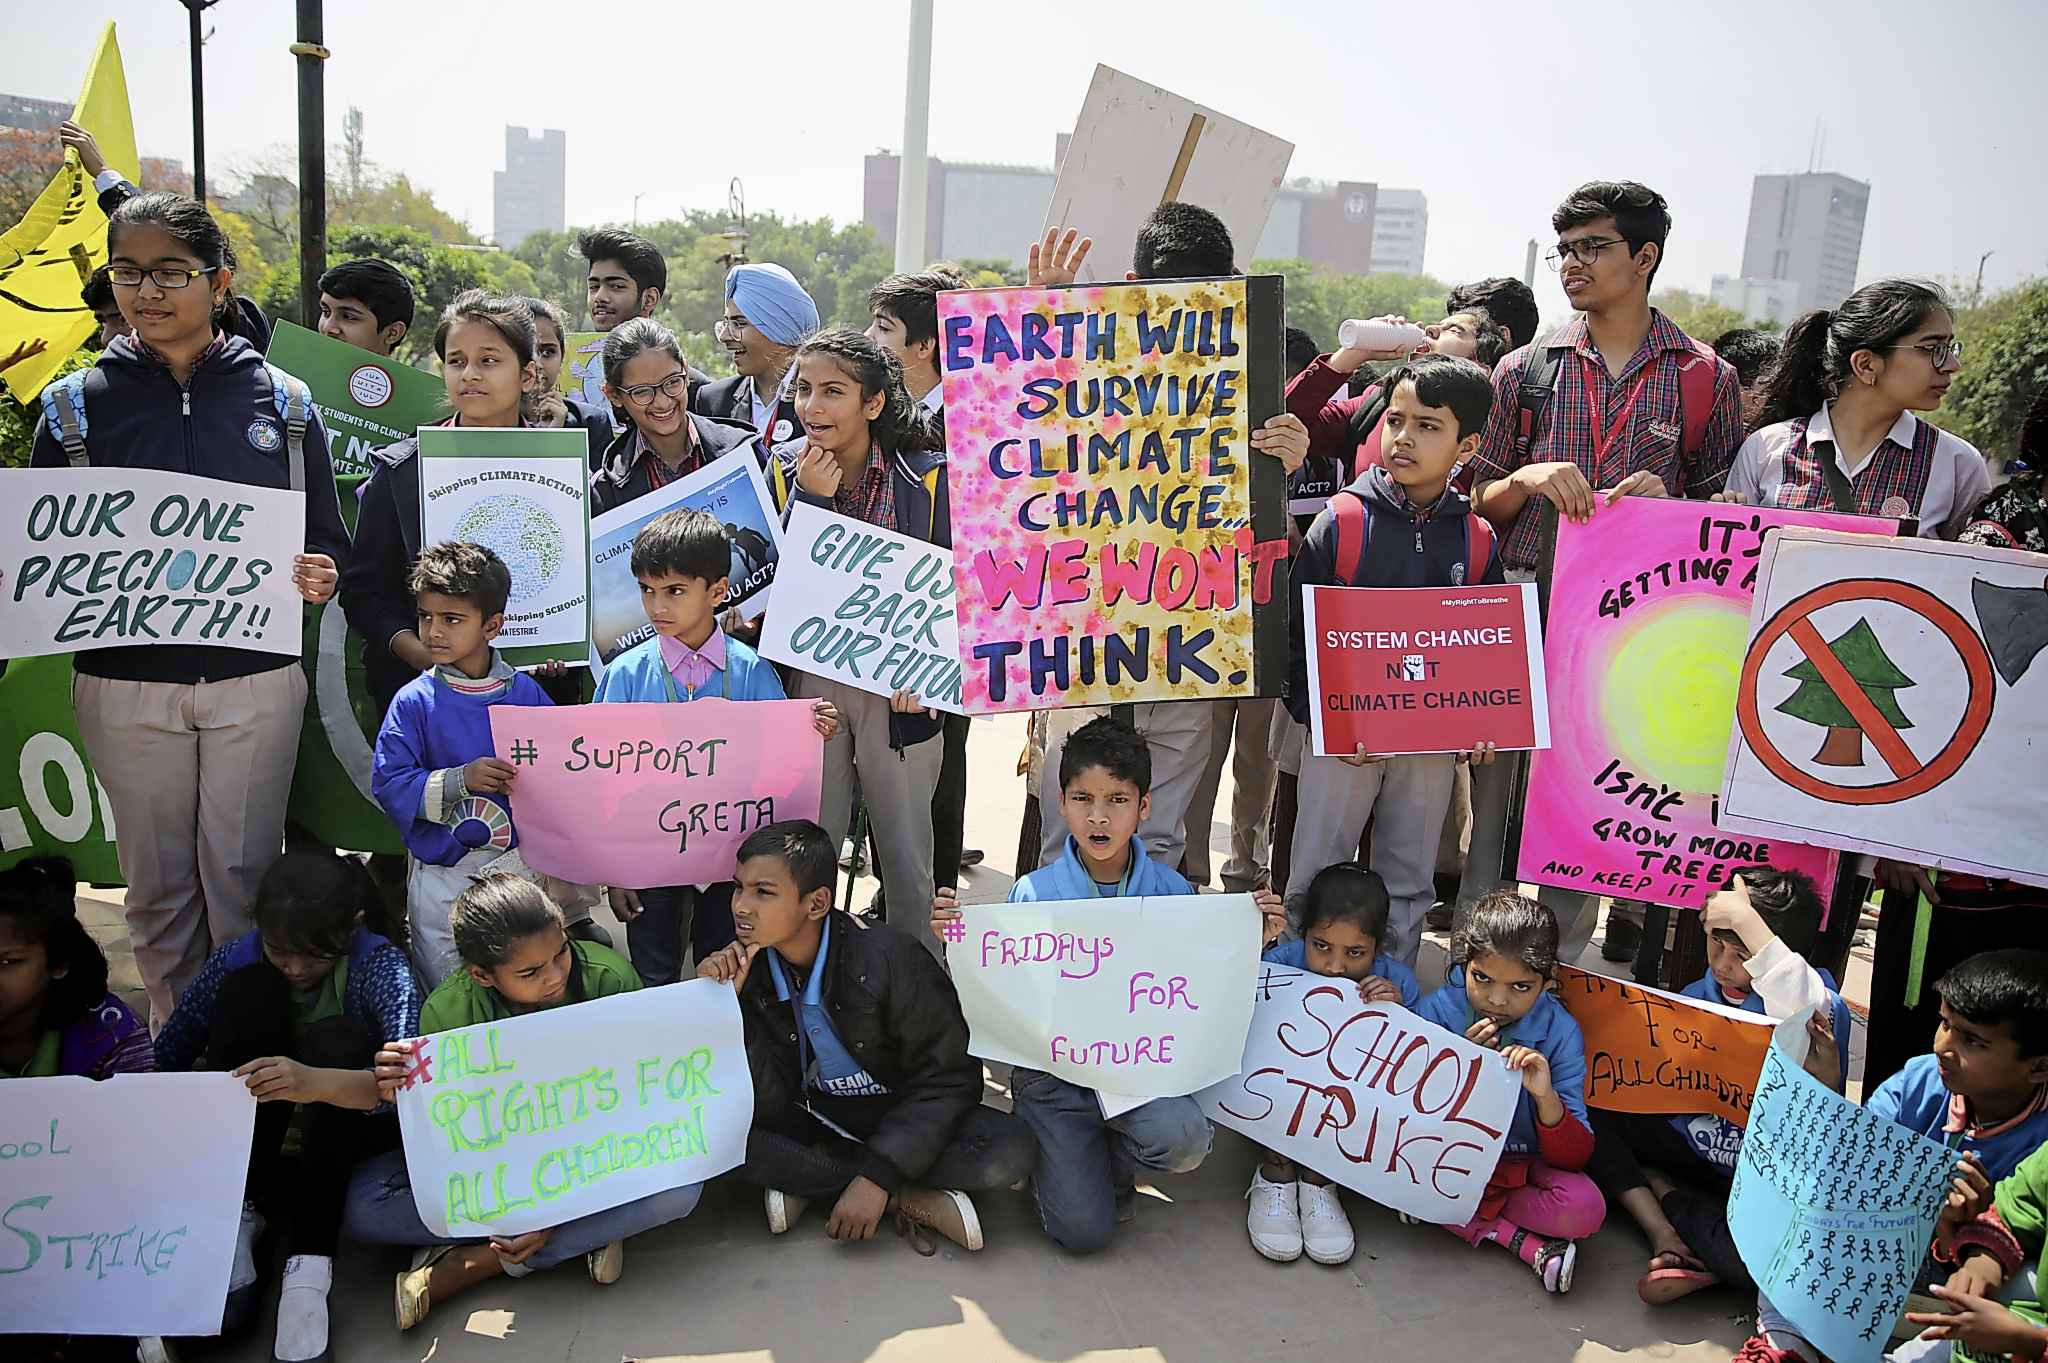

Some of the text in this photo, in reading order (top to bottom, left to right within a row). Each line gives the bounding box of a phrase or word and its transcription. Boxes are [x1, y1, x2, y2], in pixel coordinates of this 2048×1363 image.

[944, 306, 1240, 371] EARTH WILL
[1016, 370, 1240, 420] SURVIVE
[324, 407, 363, 428] STUDENTS
[364, 421, 380, 433] FOR
[988, 427, 1236, 480] CLIMATE
[427, 470, 584, 500] Skipping CLIMATE ACTION
[717, 495, 728, 508] IS
[1297, 481, 1331, 494] ACT?
[27, 490, 254, 542] OUR ONE
[13, 548, 273, 601] PRECIOUS
[744, 562, 775, 591] ACT?
[811, 523, 956, 600] GIVE US
[973, 539, 1091, 611] WE
[504, 595, 586, 622] skipping SCHOOL!
[1599, 557, 1732, 619] GETTING
[54, 594, 272, 643] EARTH!!
[835, 583, 953, 648] BACK
[1326, 627, 1512, 649] SYSTEM CHANGE
[790, 616, 963, 705] OUR FUTUR
[973, 624, 1248, 702] THINK.
[1327, 688, 1522, 712] CLIMATE CHANGE
[510, 736, 727, 777] # SUPPORT
[658, 796, 775, 853] GRETA
[1592, 817, 1769, 863] GROW MORE
[1540, 861, 1695, 898] AND KEEP IT
[1636, 851, 1736, 885] TREE
[1129, 972, 1199, 1013] FOR
[1051, 1035, 1175, 1065] FUTURE
[1277, 986, 1503, 1141] SCHOOL
[1588, 1051, 1655, 1098] ALL
[431, 1045, 723, 1152] RIGHTS FOR
[824, 1070, 873, 1090] TEAM
[1218, 1067, 1484, 1200] STRIKE
[445, 1104, 709, 1225] ALL CHILDREN
[0, 1195, 187, 1280] STRIKE
